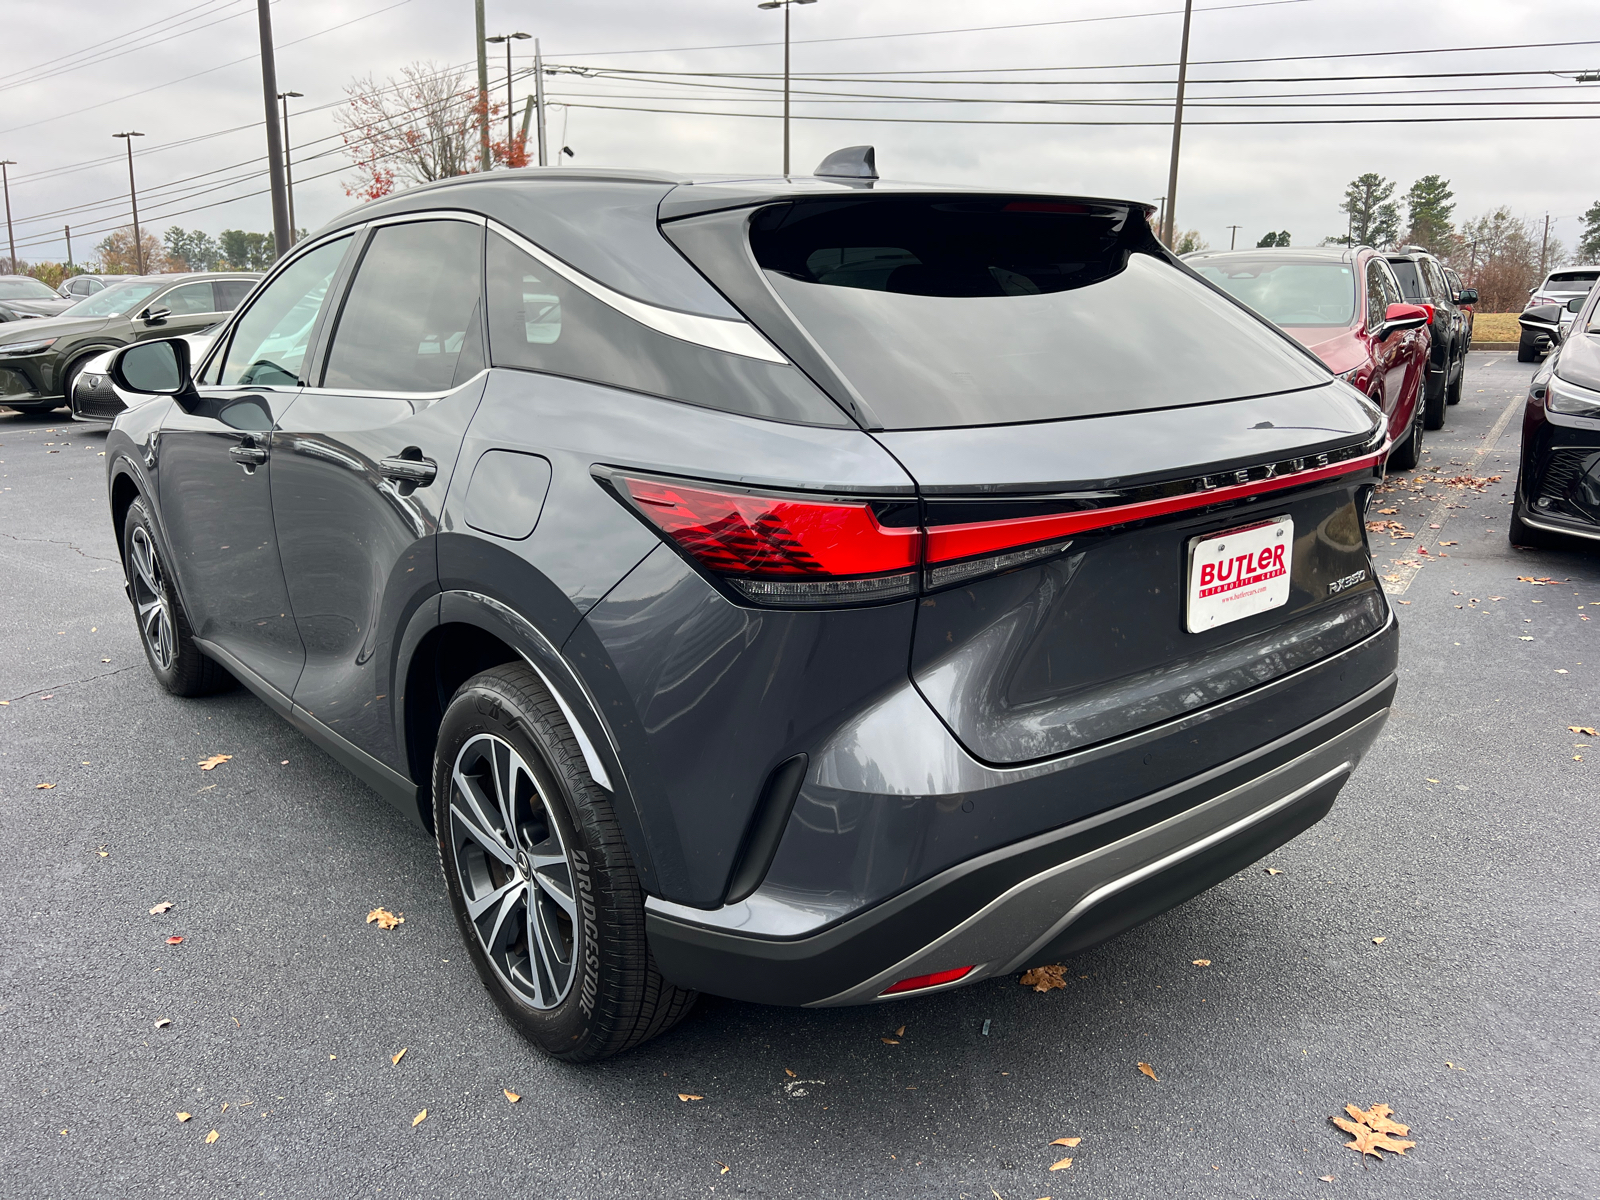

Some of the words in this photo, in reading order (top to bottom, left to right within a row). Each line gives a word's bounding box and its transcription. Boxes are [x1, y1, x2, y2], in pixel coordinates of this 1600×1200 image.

[1202, 454, 1329, 489] LEXUS
[1200, 578, 1253, 598] AUTOMOTIVE
[1261, 567, 1285, 581] GROUP
[1222, 586, 1266, 603] www.butlercars.com
[1328, 570, 1365, 594] RX350
[570, 849, 599, 1020] BRIDGESTONE
